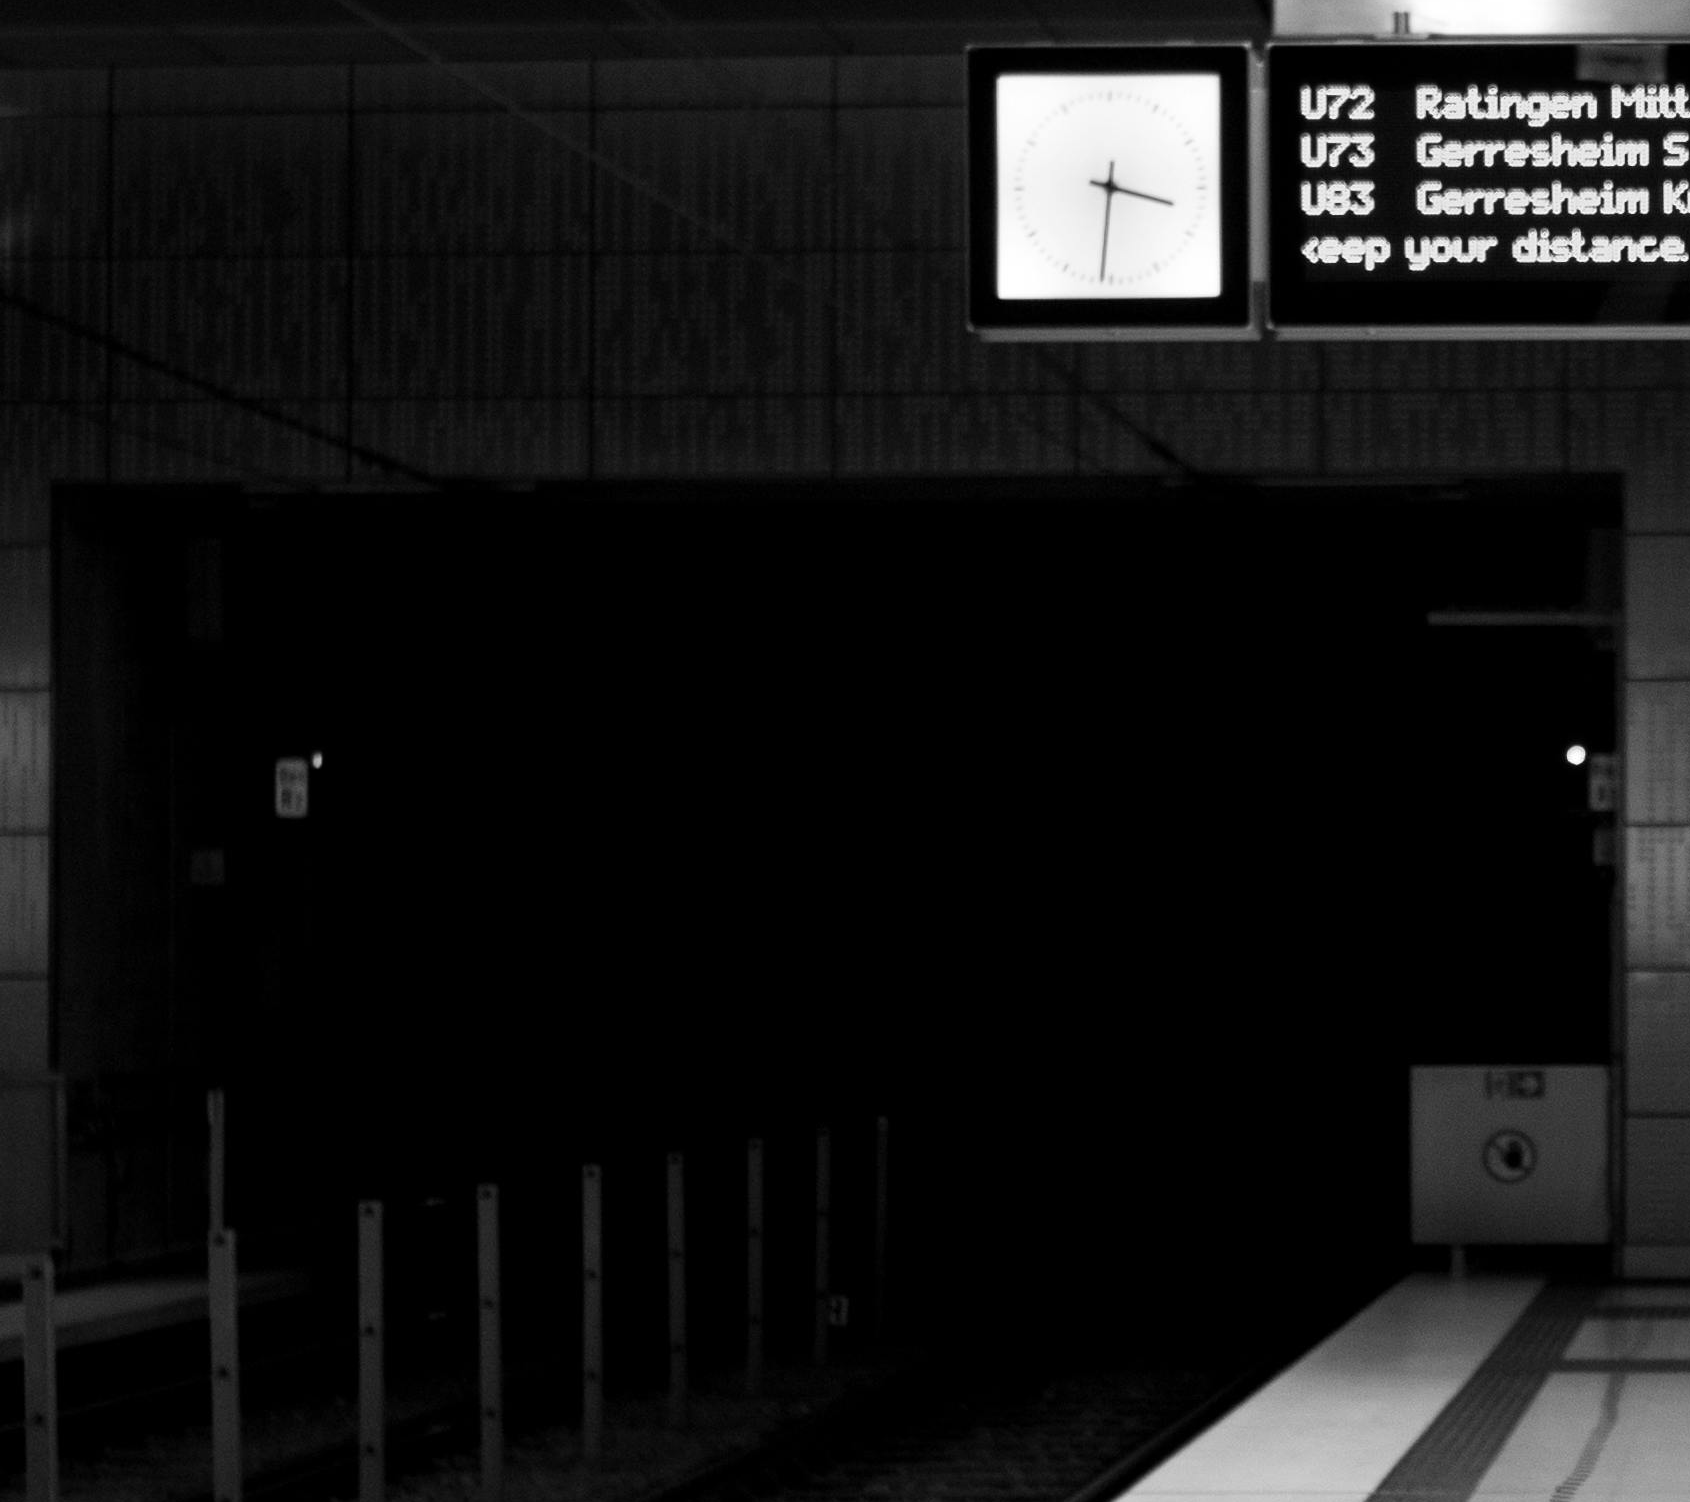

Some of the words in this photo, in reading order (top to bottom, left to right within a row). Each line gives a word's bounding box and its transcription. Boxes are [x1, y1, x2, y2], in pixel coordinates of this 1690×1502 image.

[1300, 84, 1376, 121] U72
[1415, 84, 1599, 128] Ratingen
[1300, 132, 1376, 169] U73
[1415, 131, 1650, 168] Gerresheim
[1662, 131, 1690, 167] S
[1300, 180, 1376, 216] U83
[1415, 179, 1650, 216] Gerresheim
[1403, 235, 1499, 272] your
[1511, 227, 1690, 264] distance.
